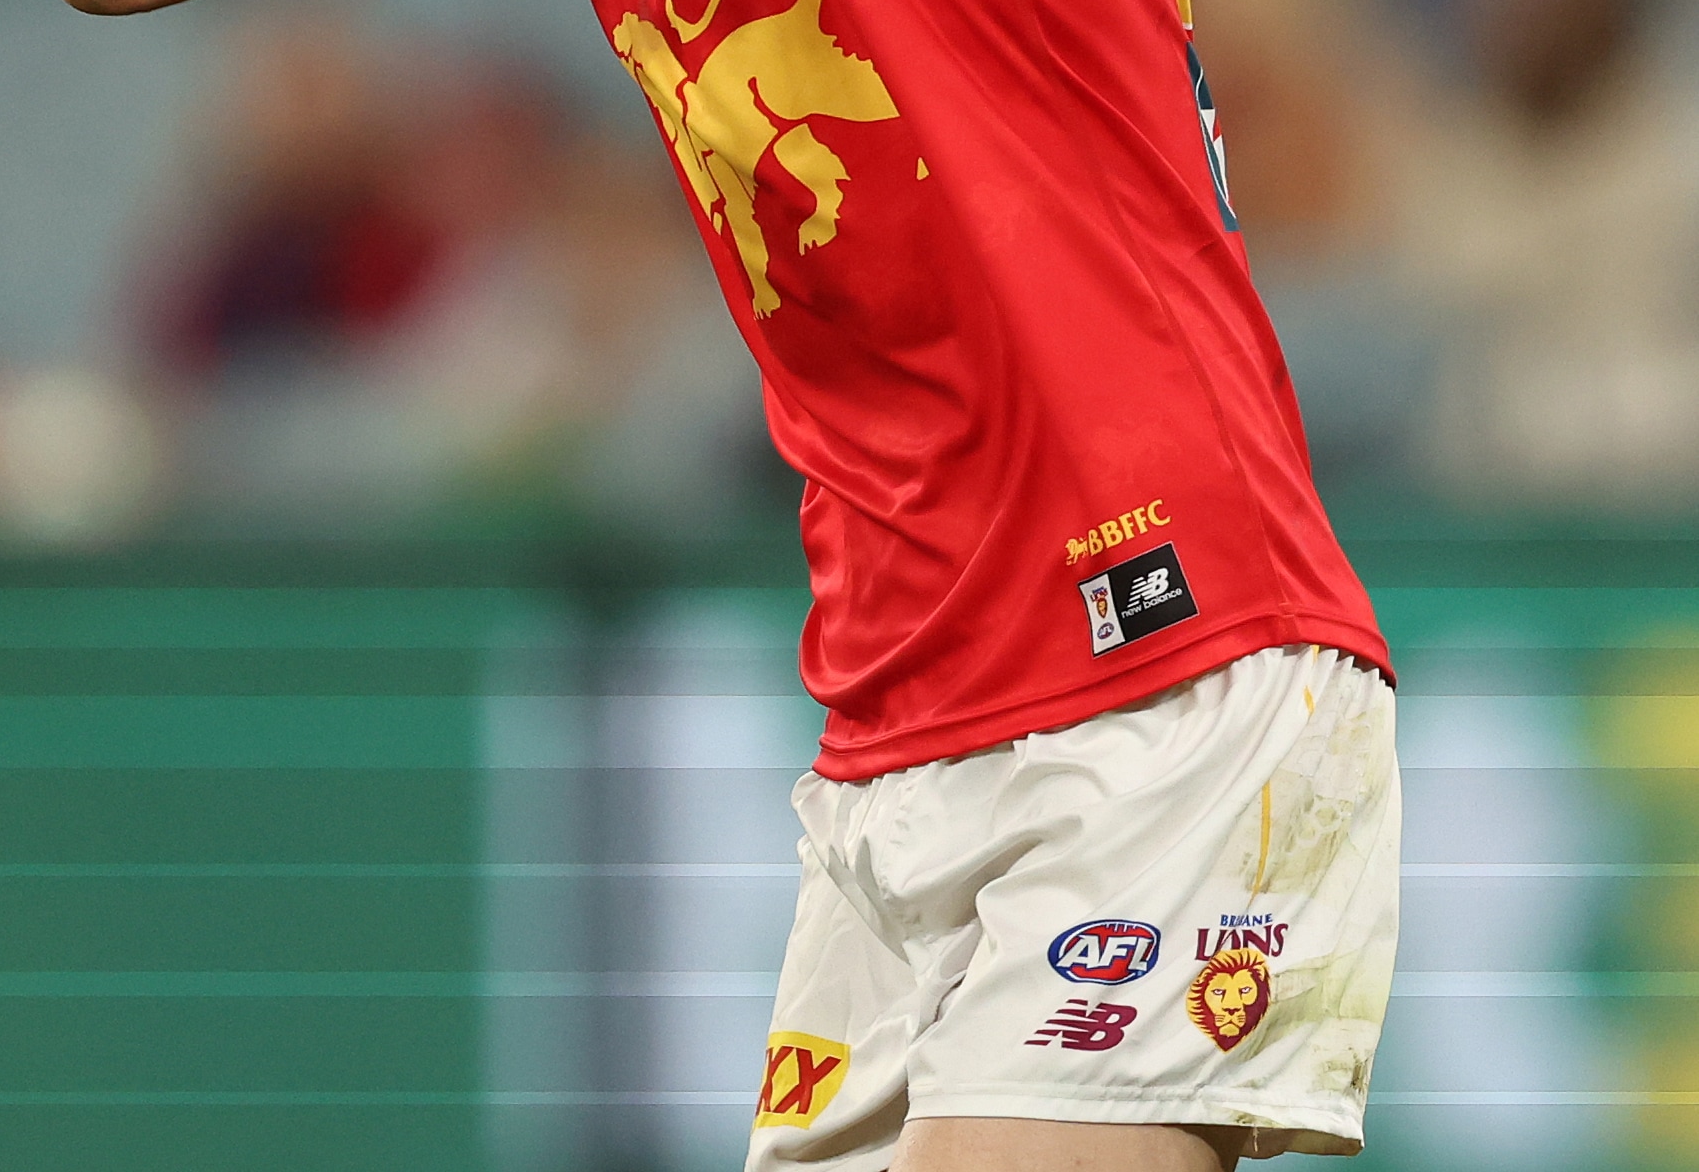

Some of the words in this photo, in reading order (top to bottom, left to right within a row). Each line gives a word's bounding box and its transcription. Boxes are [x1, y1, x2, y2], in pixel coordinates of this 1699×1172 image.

[1121, 604, 1142, 619] new
[1142, 588, 1183, 610] balance
[1056, 934, 1153, 971] AFL
